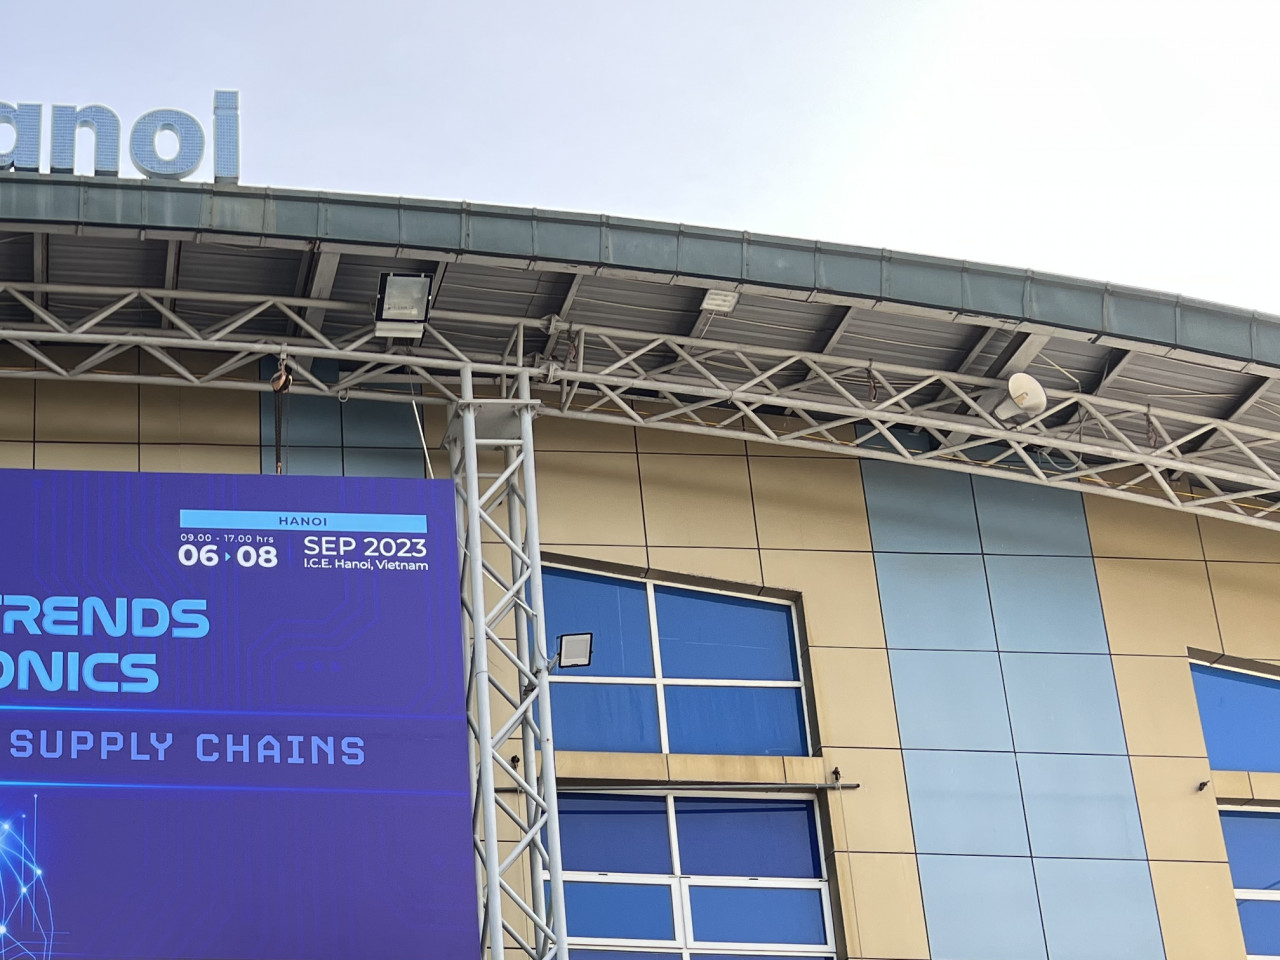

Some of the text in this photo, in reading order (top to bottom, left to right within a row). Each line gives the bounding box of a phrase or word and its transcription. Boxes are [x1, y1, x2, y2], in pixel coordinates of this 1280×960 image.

[278, 516, 328, 527] HANOI
[180, 533, 212, 542] 09.00
[223, 534, 252, 543] 17.00
[256, 535, 274, 543] hrs
[303, 536, 427, 557] SEP 2023
[178, 544, 278, 568] 06 08
[304, 558, 428, 571] I.C.E. Hanoi, Vietnam
[10, 729, 173, 762] SUPPLY
[196, 734, 366, 766] CHAINS
